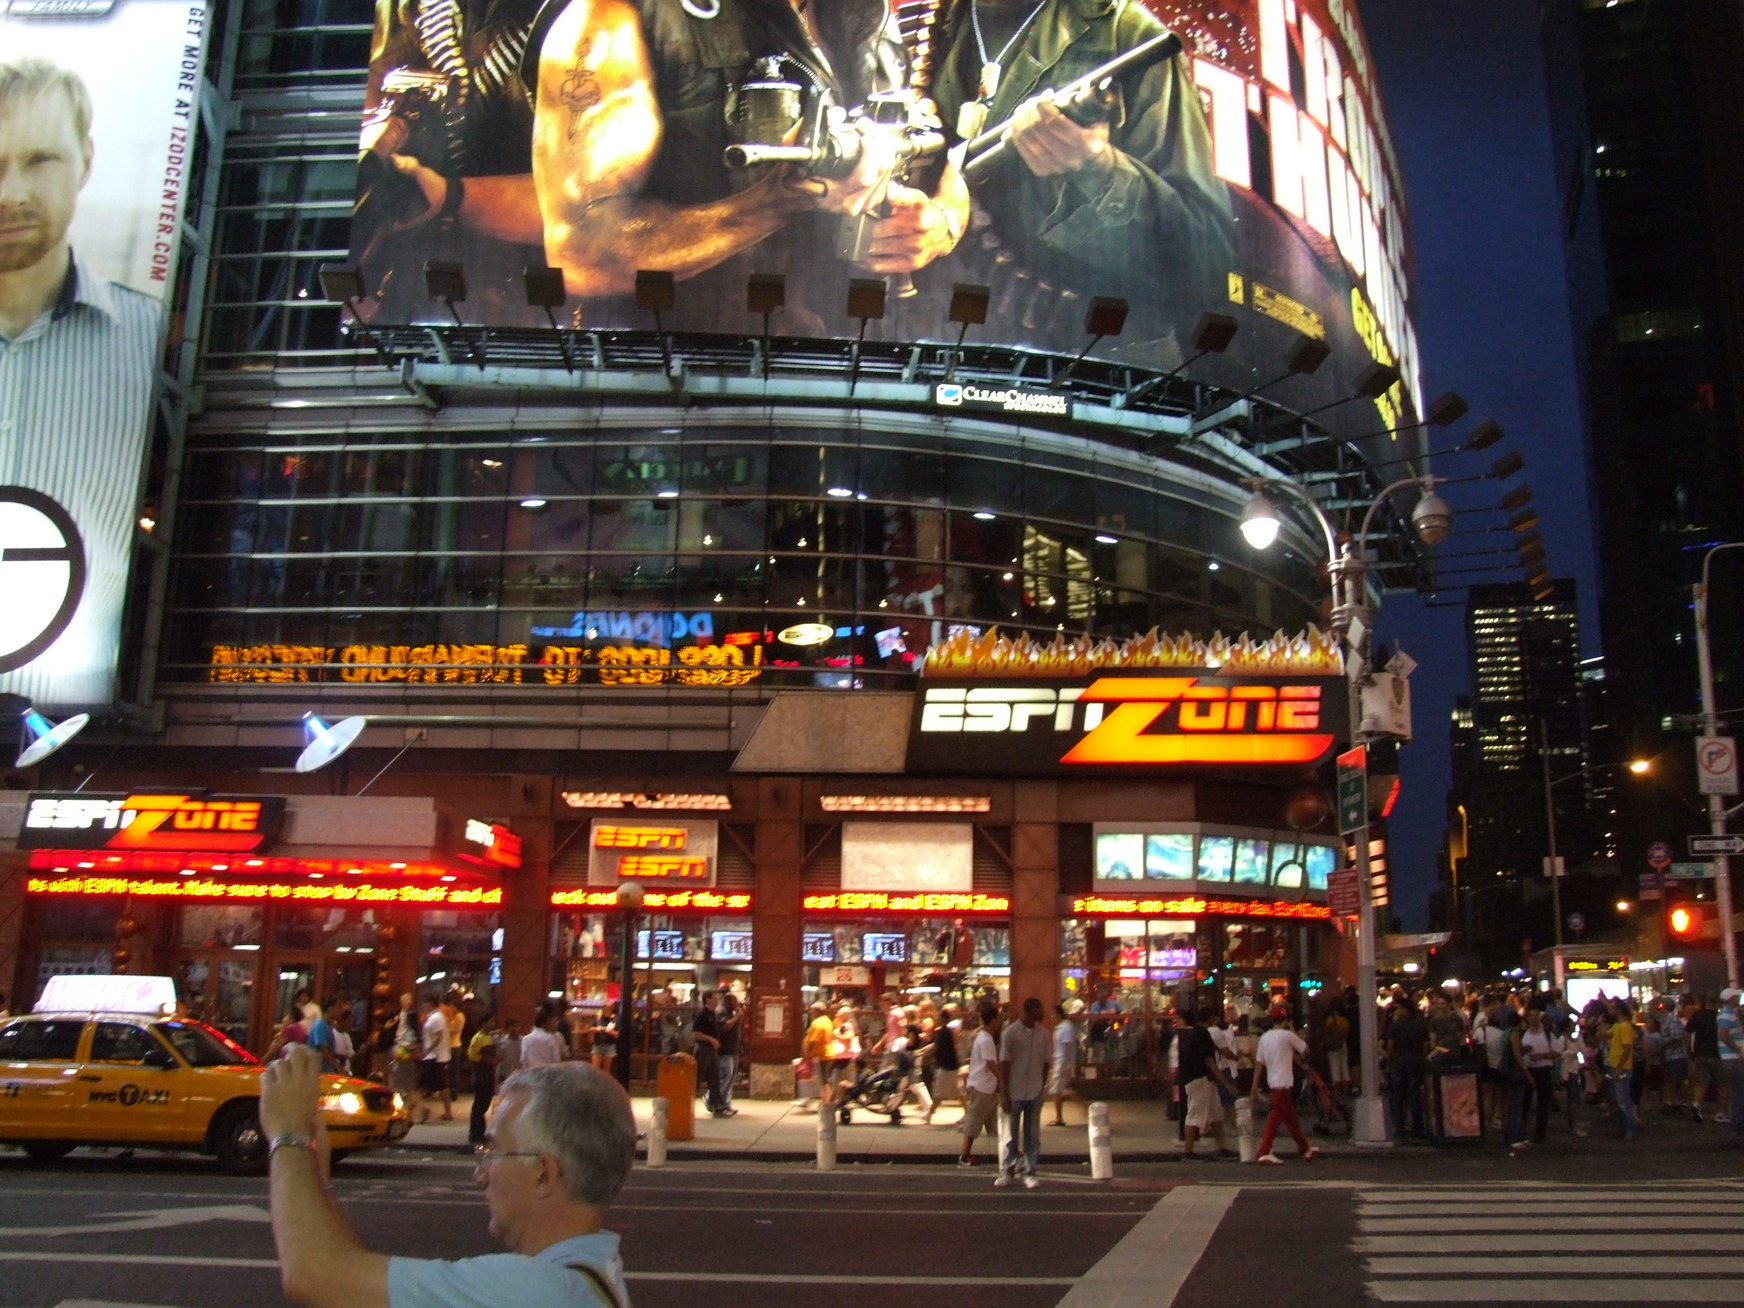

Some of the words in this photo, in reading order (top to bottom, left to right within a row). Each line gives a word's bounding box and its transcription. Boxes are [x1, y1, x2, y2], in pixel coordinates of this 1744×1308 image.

[187, 6, 206, 38] GET
[177, 45, 201, 92] MORE
[174, 99, 191, 120] AT
[149, 126, 189, 282] IZODCENTER.COM
[920, 687, 1104, 733] ESPN
[1059, 677, 1335, 764] ZONE
[26, 798, 138, 829] ESPN
[103, 795, 265, 849] ZONE
[593, 826, 687, 849] ESPN
[617, 856, 706, 877] ESPN
[84, 878, 128, 894] ESPN
[838, 893, 888, 909] ESPN
[924, 894, 972, 911] ESPN
